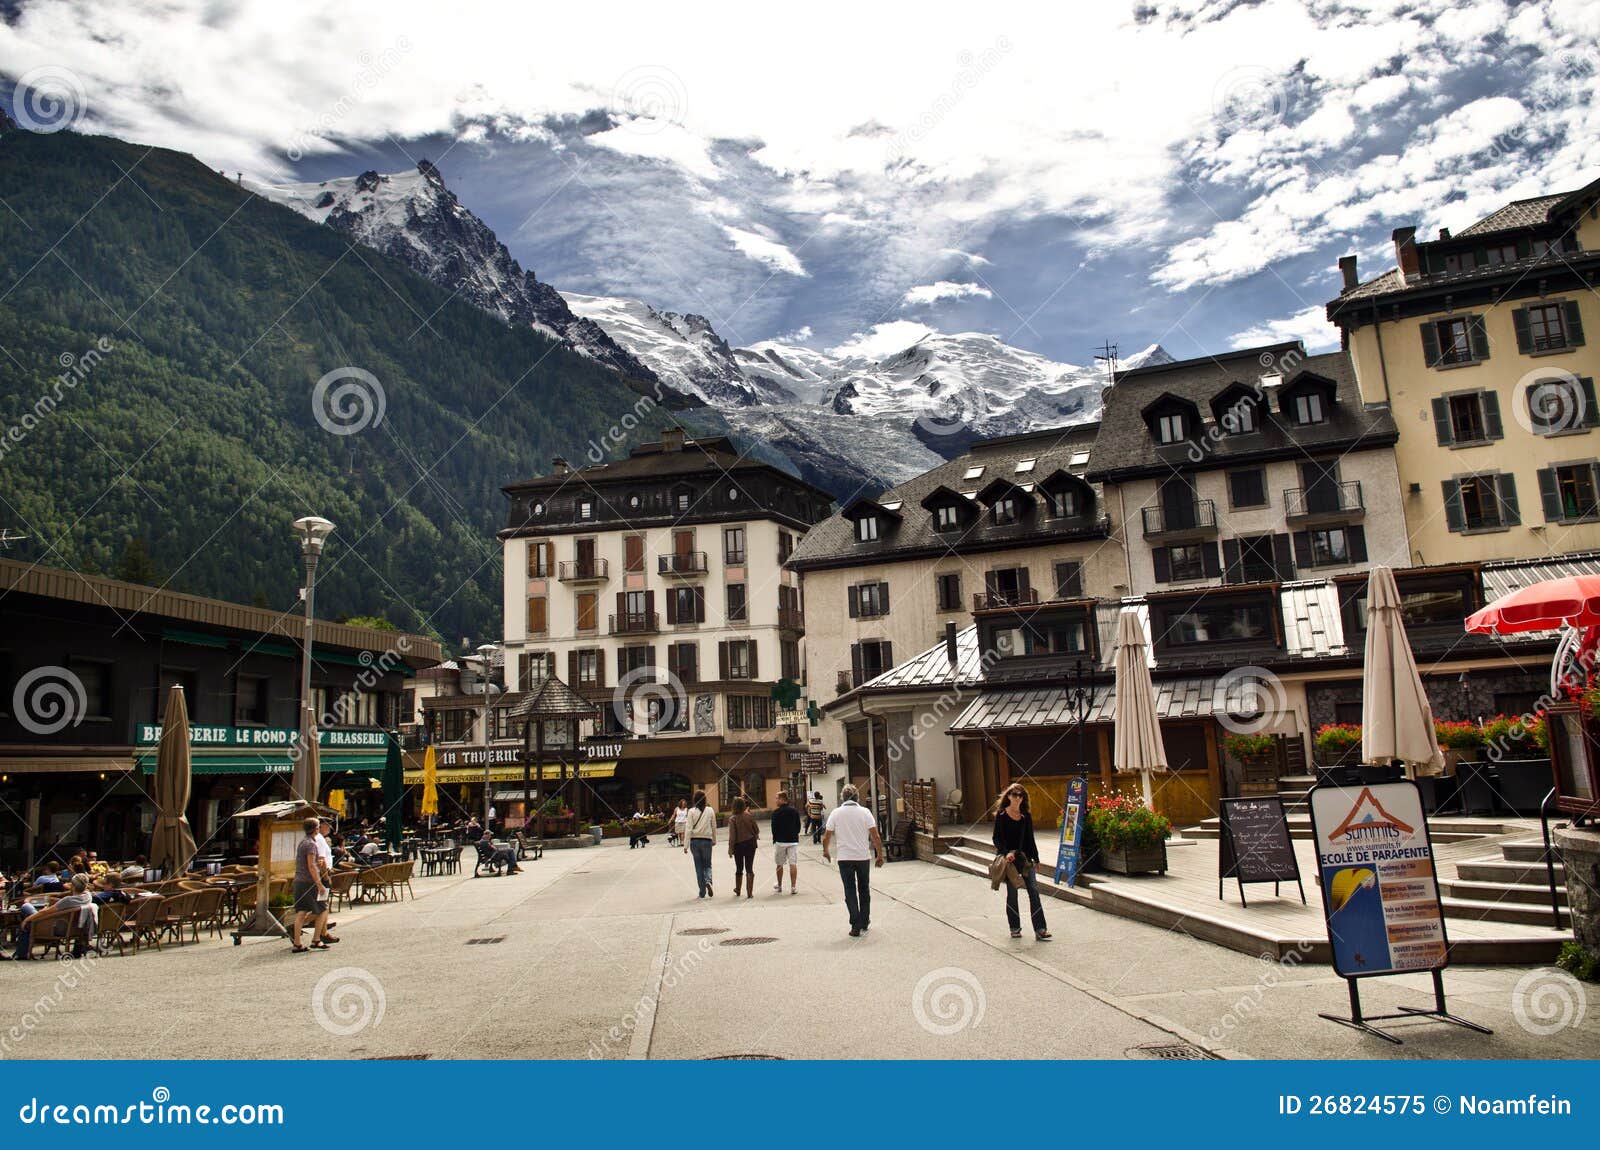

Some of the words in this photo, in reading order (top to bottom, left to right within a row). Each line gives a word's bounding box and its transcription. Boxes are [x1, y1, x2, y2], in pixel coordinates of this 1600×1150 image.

[143, 726, 227, 742] BRSERIE
[236, 729, 250, 743] LE
[253, 730, 286, 743] ROND
[330, 732, 385, 744] BRASSERIE
[1320, 852, 1353, 865] ECOLE
[1356, 850, 1370, 862] DE
[1373, 847, 1429, 861] PARAPENTE
